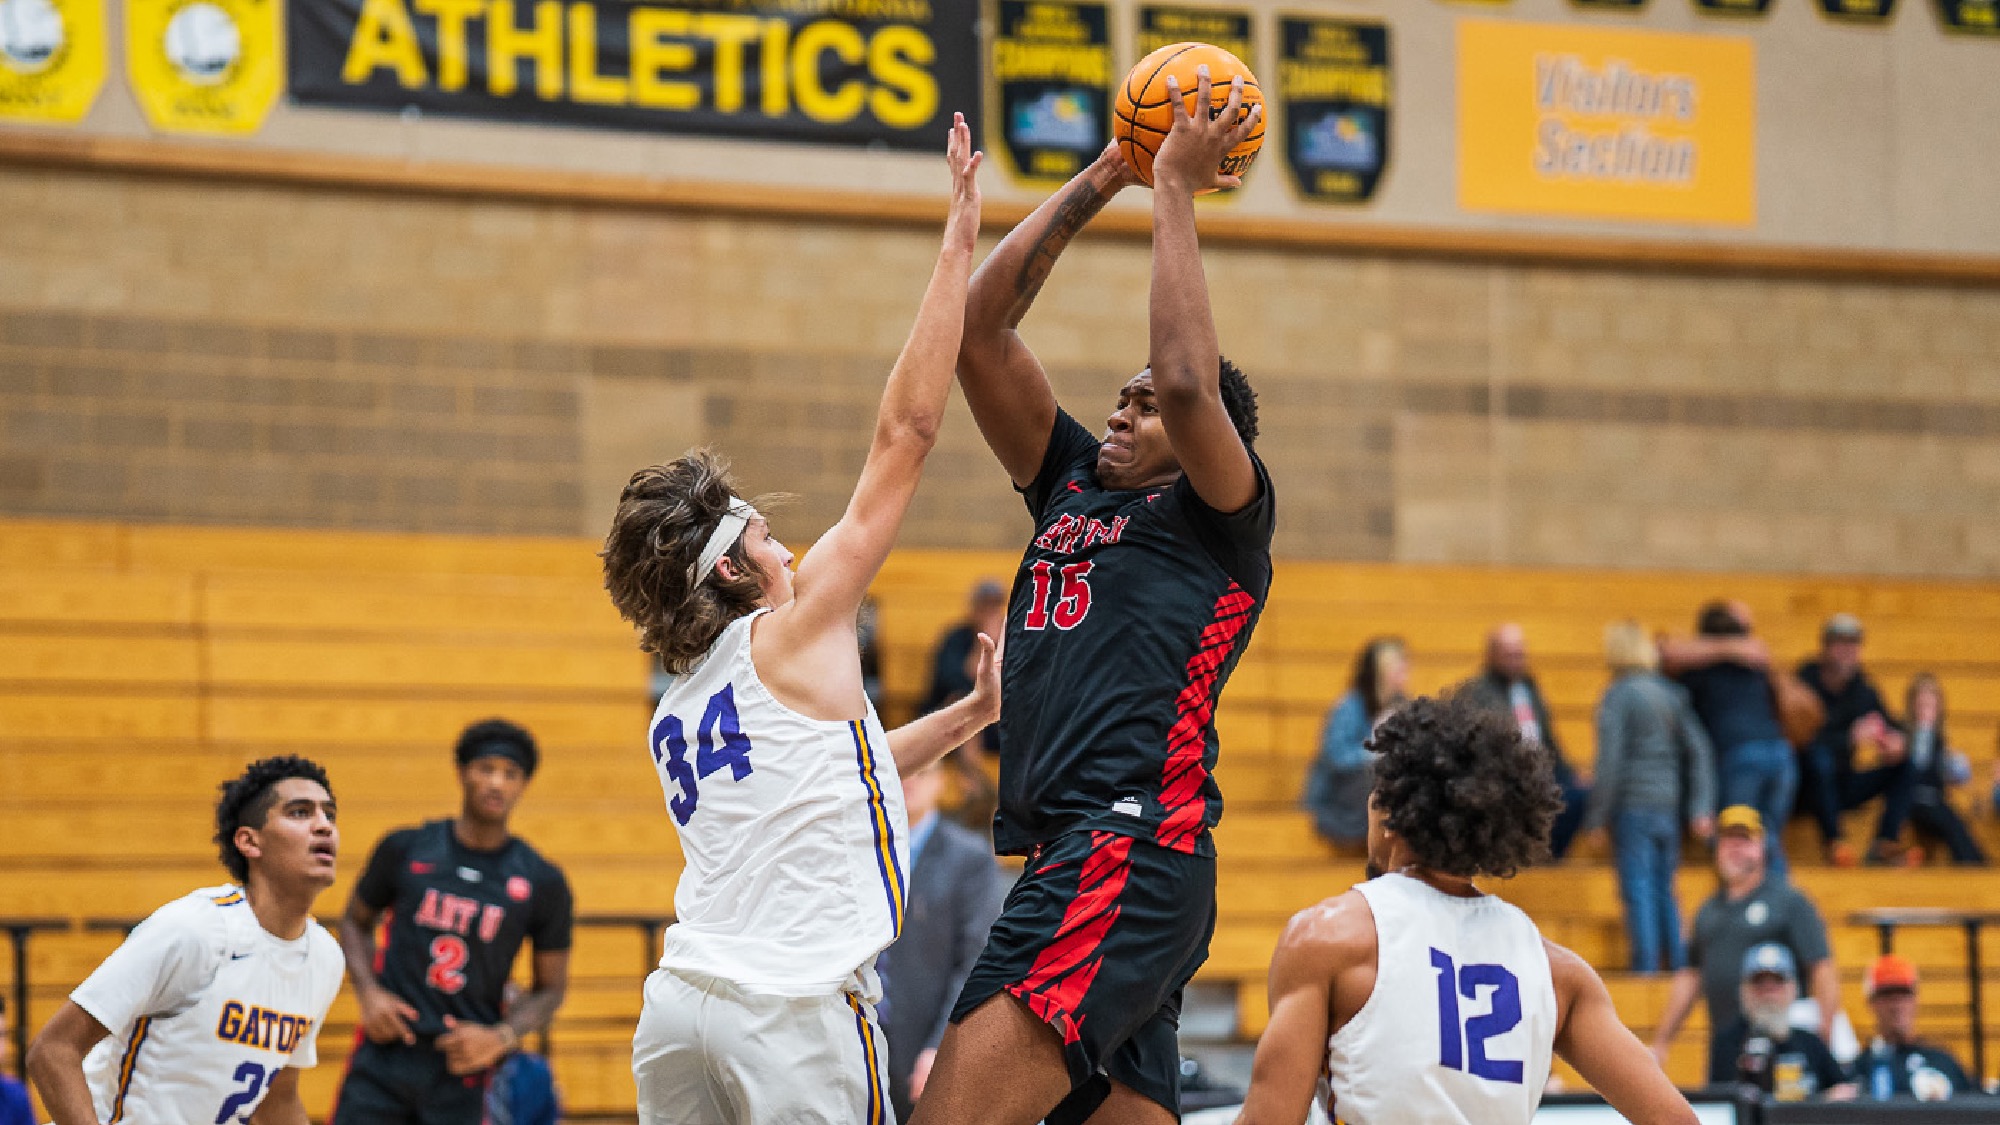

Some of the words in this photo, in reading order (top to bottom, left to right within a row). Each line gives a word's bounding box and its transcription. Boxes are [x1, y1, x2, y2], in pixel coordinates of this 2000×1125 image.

[341, 0, 940, 129] ATHLETICS
[1534, 52, 1697, 123] Visitors
[1533, 115, 1698, 188] Section
[1024, 559, 1096, 631] 15
[652, 682, 754, 827] 34
[426, 933, 469, 995] 2
[216, 998, 316, 1056] GATOR
[1428, 946, 1524, 1085] 12
[214, 1060, 281, 1125] 2
